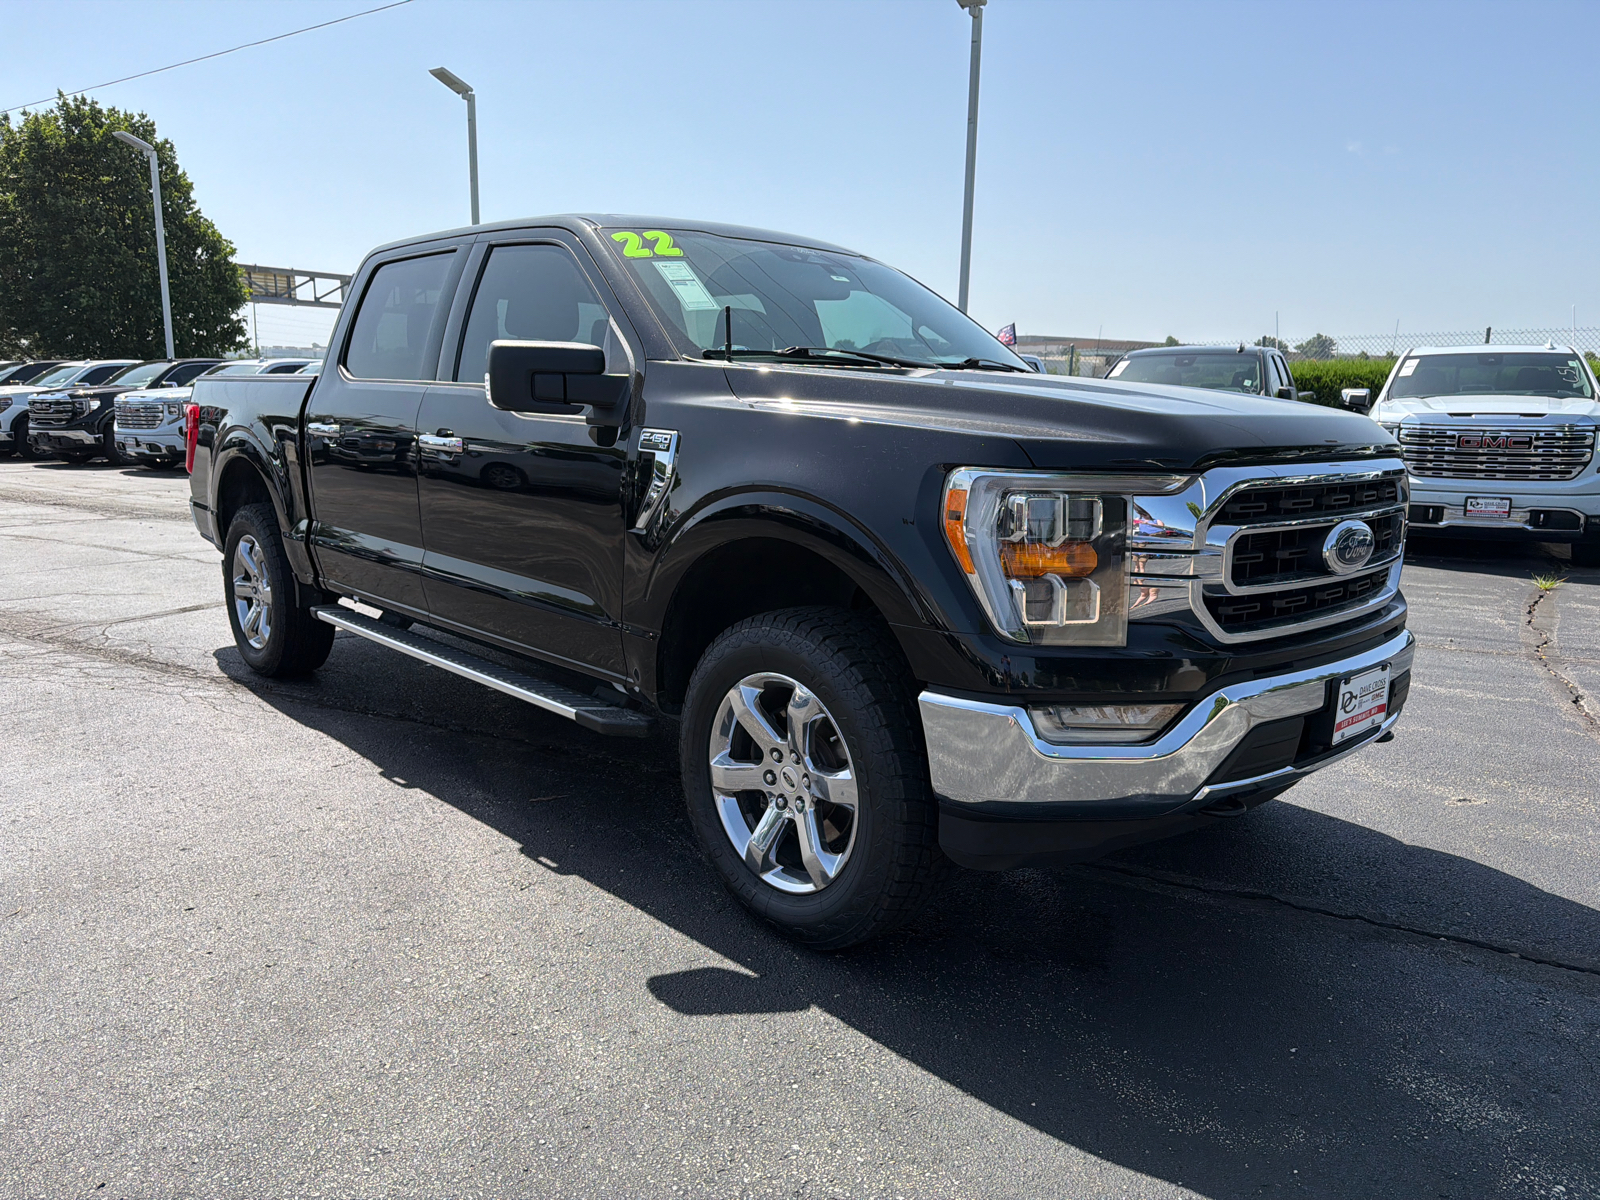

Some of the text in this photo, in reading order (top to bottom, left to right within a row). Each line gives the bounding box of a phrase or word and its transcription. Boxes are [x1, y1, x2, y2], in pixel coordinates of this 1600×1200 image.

[611, 230, 684, 257] 22
[641, 432, 671, 444] F-150
[1460, 436, 1530, 448] GMC
[1339, 535, 1371, 559] Ford
